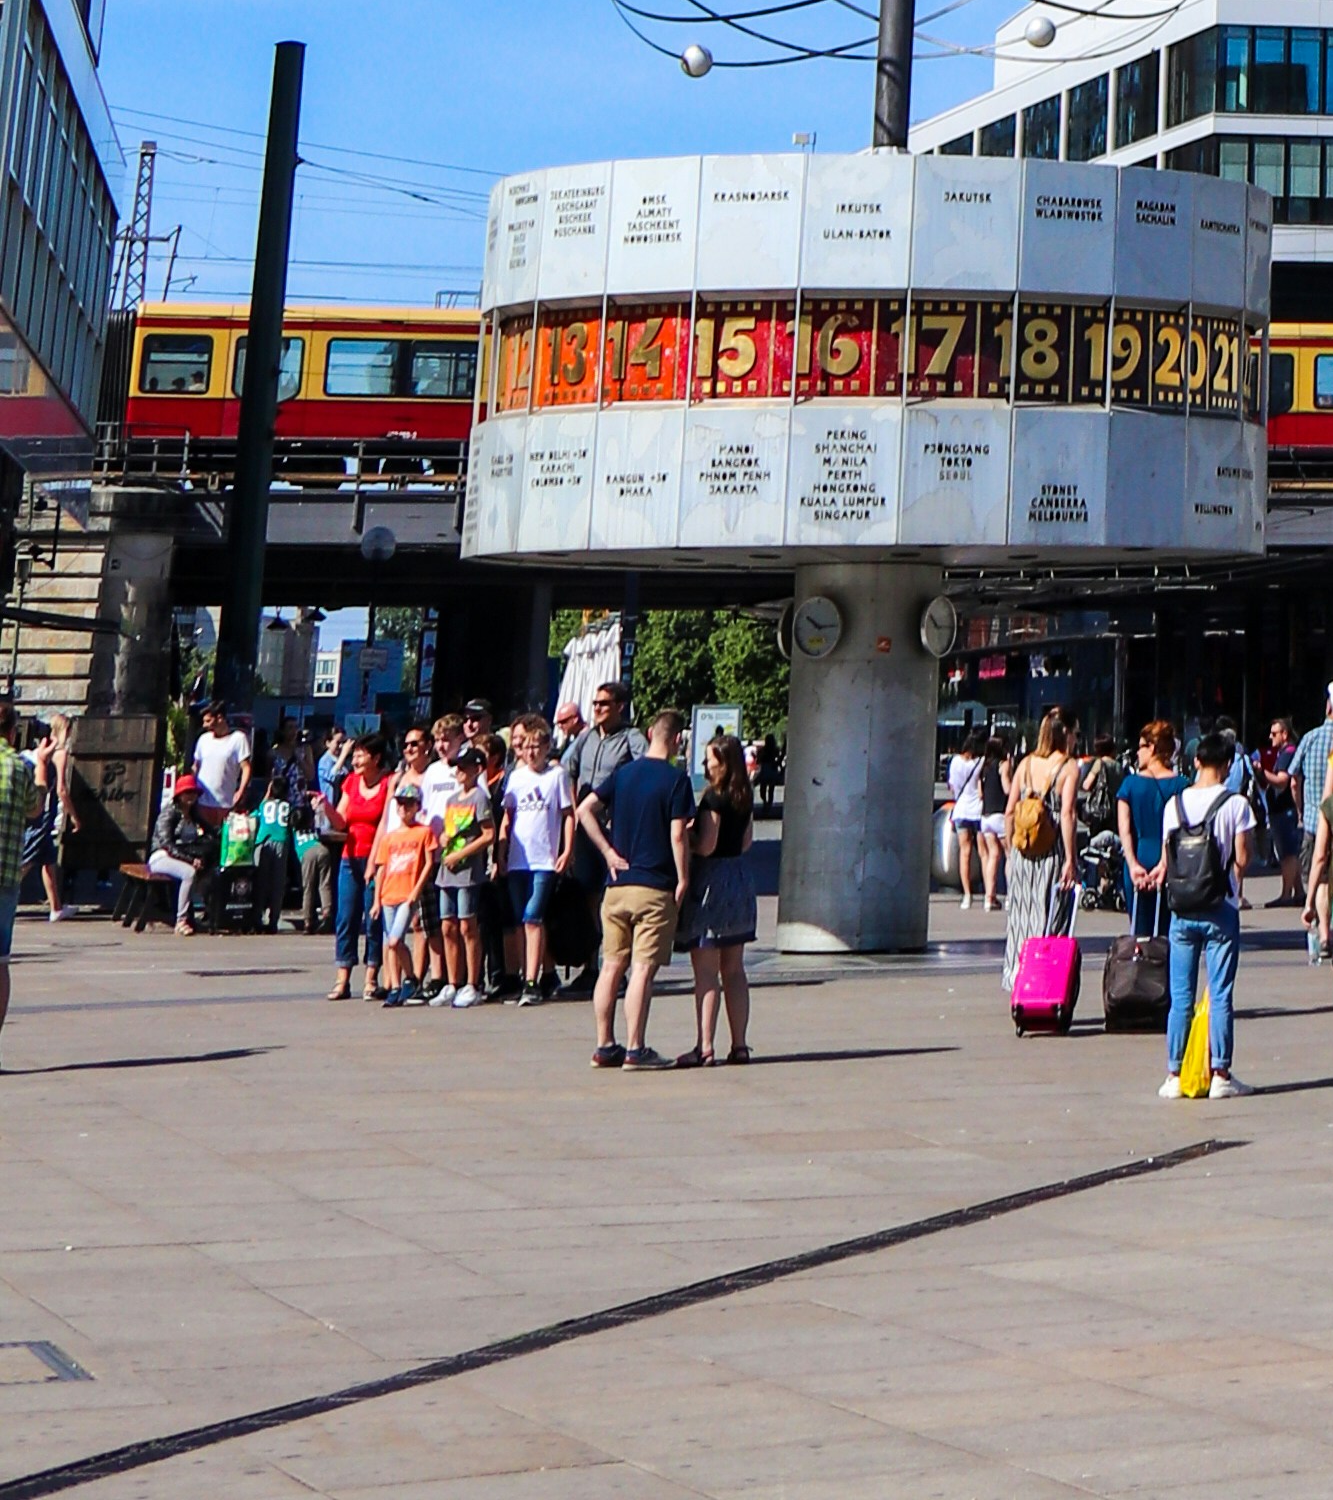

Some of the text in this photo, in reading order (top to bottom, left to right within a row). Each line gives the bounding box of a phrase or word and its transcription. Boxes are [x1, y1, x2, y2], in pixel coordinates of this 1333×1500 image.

[550, 185, 605, 200] JEKATERINBURG
[714, 191, 789, 202] KRASNOJARSK
[944, 192, 991, 202] JAKUTSK
[642, 195, 667, 205] OMSK
[1036, 196, 1102, 208] CHABAROWSK
[556, 199, 598, 213] ASCHGABAT
[836, 204, 882, 213] IRKUTSK
[636, 207, 672, 218] ALMATY
[1035, 209, 1103, 221] WLADIWOSTOK
[1136, 213, 1176, 226] SACHALIN
[627, 219, 680, 232] TASCHKENT
[624, 232, 682, 244] NOWOSIBIRSK
[823, 229, 892, 239] ULAN-BATOR
[608, 318, 663, 380] 14
[695, 316, 756, 378] 15
[787, 313, 860, 376] 16
[890, 315, 967, 376] 17
[994, 316, 1060, 380] 18
[549, 322, 588, 384] 13
[1084, 322, 1142, 382] 19
[1154, 326, 1208, 391] 20
[1213, 332, 1239, 393] 21
[827, 430, 867, 440] PEKING
[719, 444, 754, 455] HANOI
[814, 443, 877, 454] SHANGHAI
[924, 442, 990, 455] PJÖNGJANG
[549, 451, 571, 461] DELHI
[711, 457, 760, 468] BANGKOK
[941, 457, 973, 467] TOKYO
[540, 464, 575, 474] KARACHI
[606, 474, 645, 484] RANGUN
[699, 471, 771, 482] PHNOM PENH
[827, 470, 862, 480] PERTH
[939, 471, 973, 481] SEOUL
[531, 476, 564, 488] COLOMBO
[619, 487, 653, 498] DHAKA
[709, 485, 759, 495] JAKARTA
[813, 483, 876, 493] HONGKONG
[1041, 484, 1078, 496] SYDNEY
[800, 496, 886, 506] KUALA LUMPUR
[1031, 497, 1087, 509] CANBERRA
[814, 510, 872, 520] SINGAPUR
[1028, 510, 1089, 523] MELBOURNE
